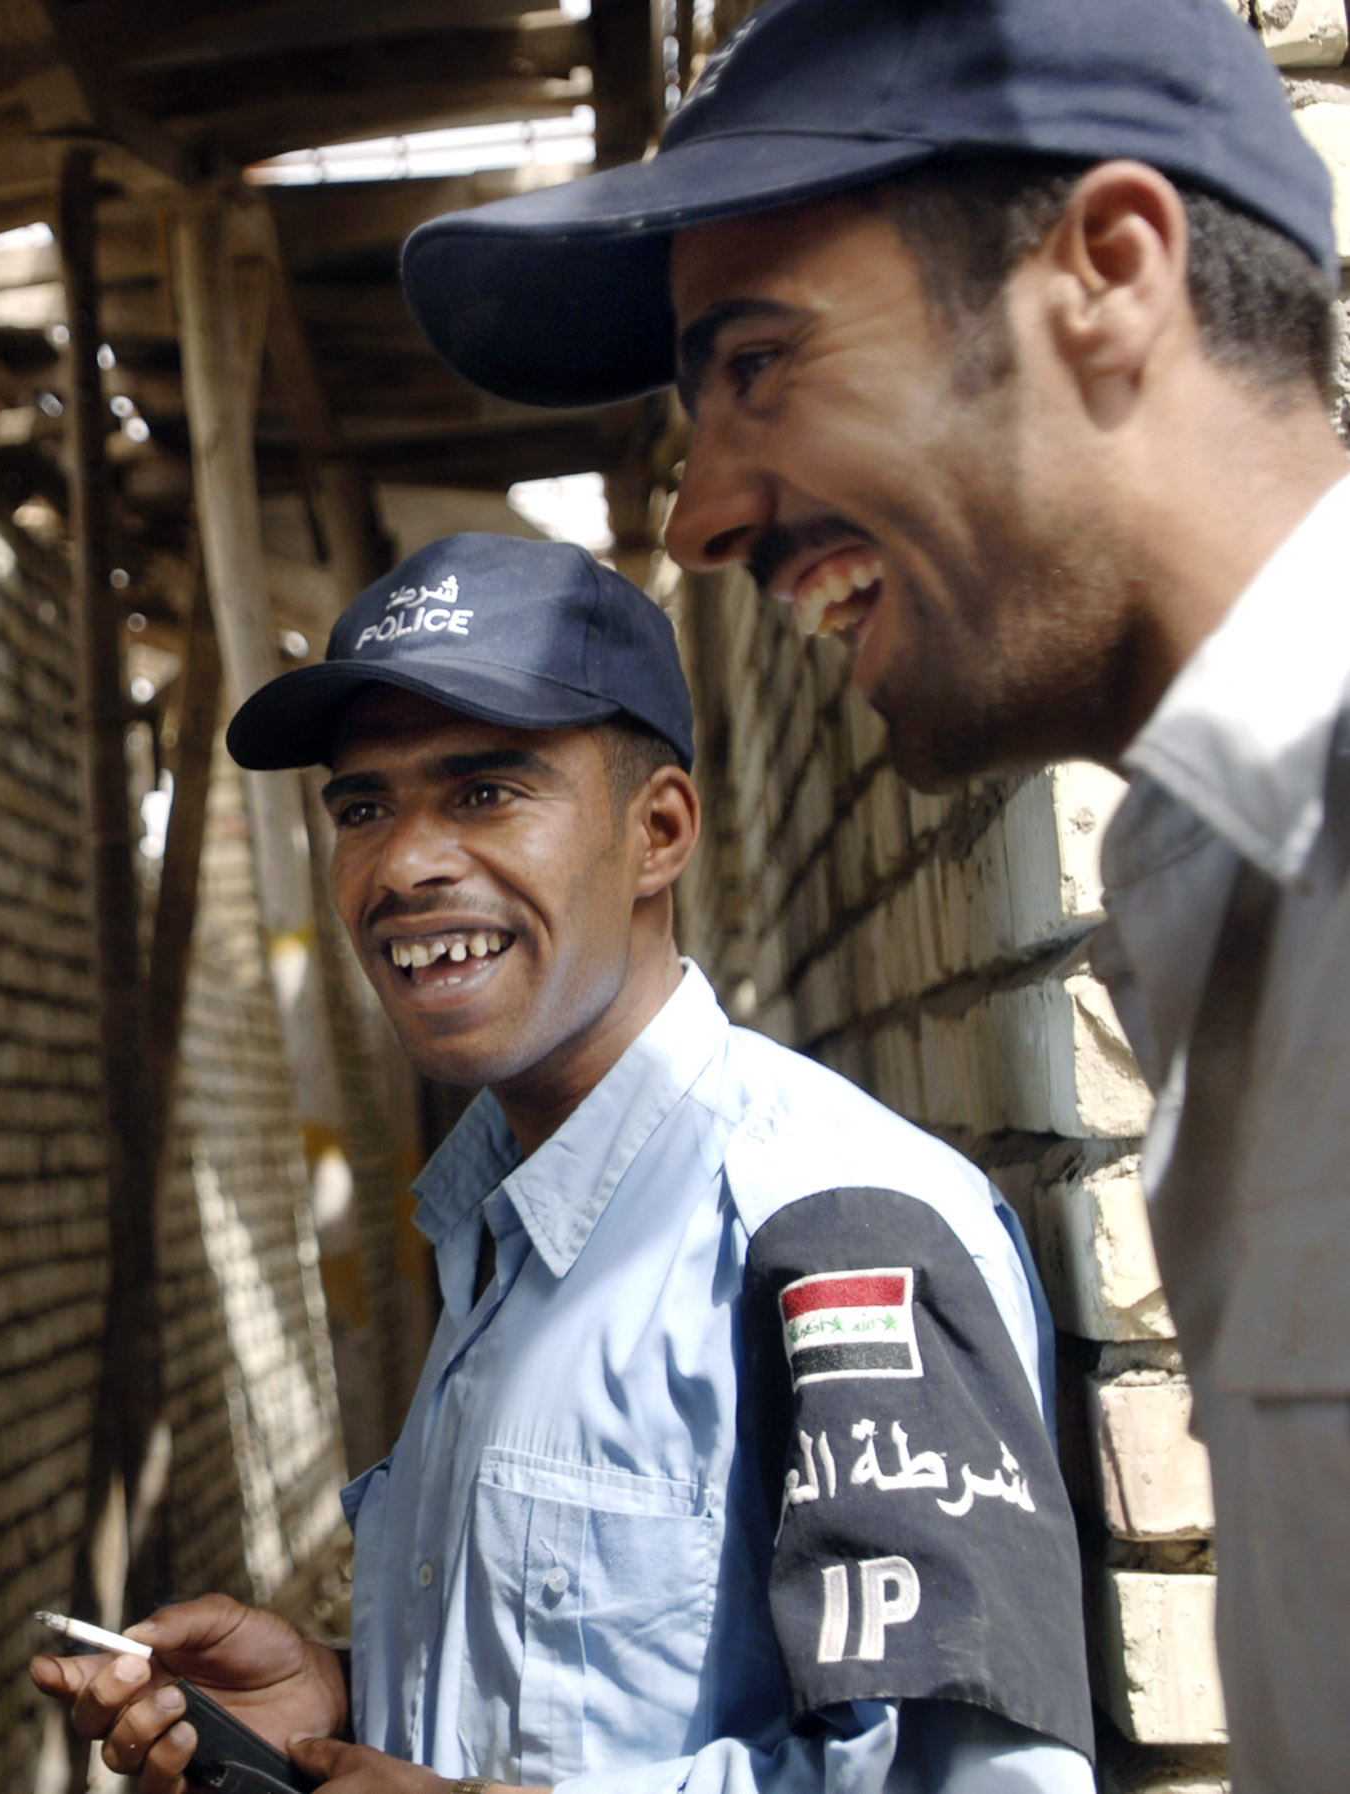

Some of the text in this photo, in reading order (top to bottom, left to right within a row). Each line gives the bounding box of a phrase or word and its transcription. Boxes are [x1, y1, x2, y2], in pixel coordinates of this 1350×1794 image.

[355, 607, 474, 650] POLICE
[850, 1418, 1036, 1517] شرطة
[819, 1556, 920, 1663] IP
